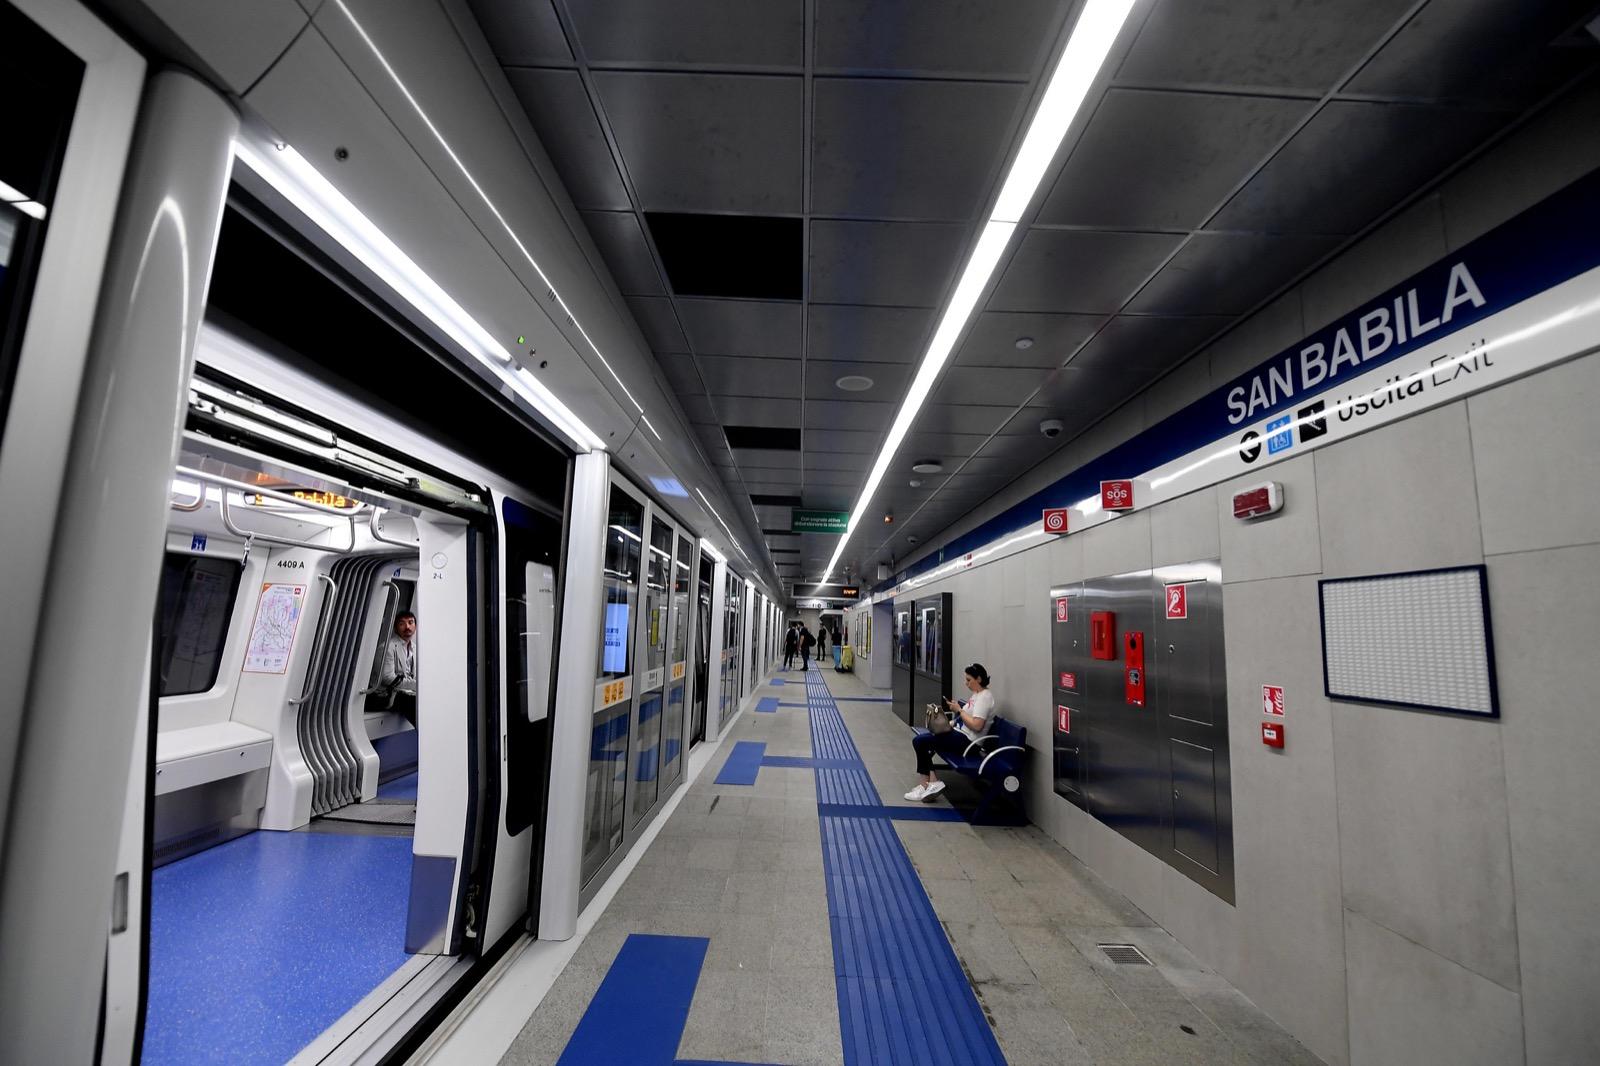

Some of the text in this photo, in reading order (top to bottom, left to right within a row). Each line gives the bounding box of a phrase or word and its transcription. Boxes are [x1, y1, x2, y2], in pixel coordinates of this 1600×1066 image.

[1226, 261, 1487, 426] SAN BABILA
[1336, 338, 1494, 422] Uscita Exit
[1107, 490, 1127, 499] SOS
[277, 560, 305, 569] 4409 A
